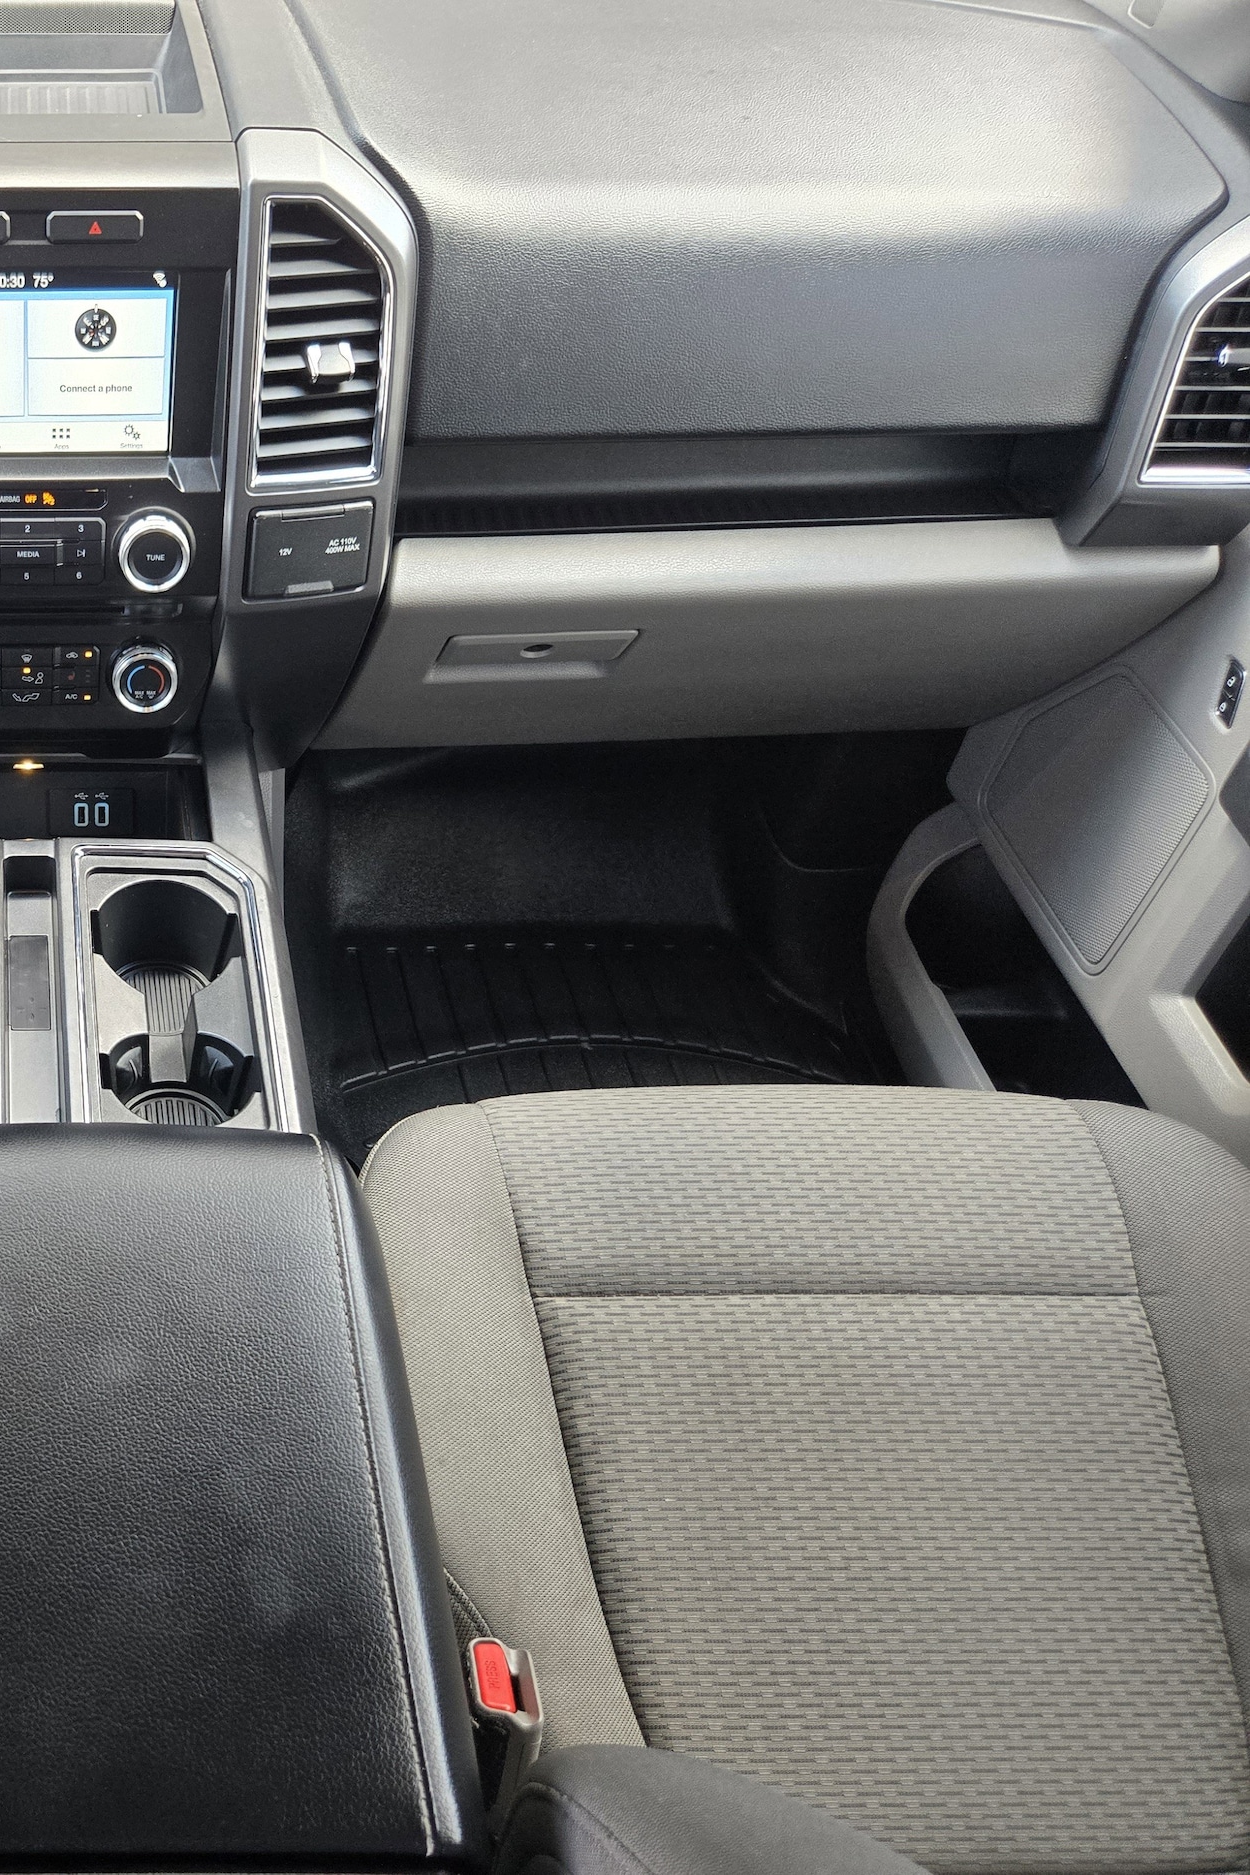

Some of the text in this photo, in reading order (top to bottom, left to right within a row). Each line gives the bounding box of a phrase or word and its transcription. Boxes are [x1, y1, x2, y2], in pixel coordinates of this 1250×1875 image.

[59, 384, 96, 393] Connect
[105, 384, 133, 394] phone
[0, 495, 21, 503] AIRBAG
[24, 494, 37, 504] OFF
[25, 525, 30, 533] 2
[329, 536, 357, 547] AC 110V
[16, 550, 40, 558] MEDIA
[278, 547, 292, 556] 12V
[325, 544, 360, 555] 400W MAX
[146, 554, 165, 562] TUNE
[65, 693, 77, 701] A/C
[485, 1660, 500, 1689] PRESS
